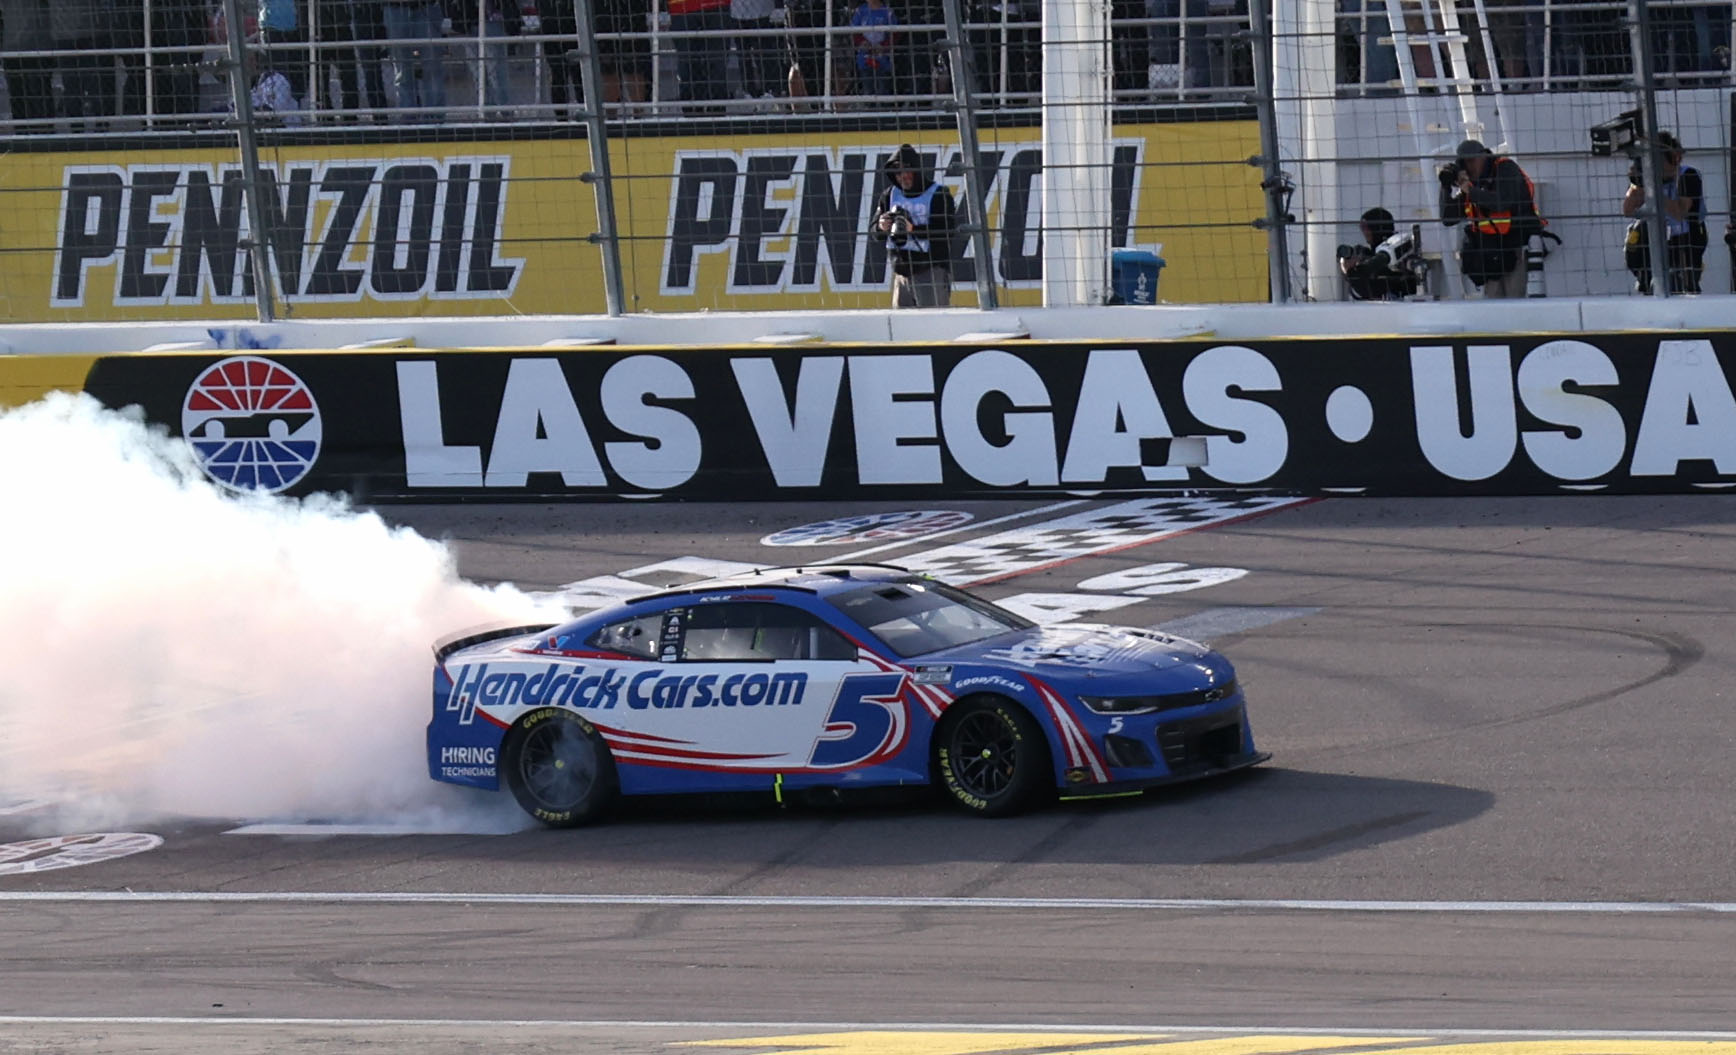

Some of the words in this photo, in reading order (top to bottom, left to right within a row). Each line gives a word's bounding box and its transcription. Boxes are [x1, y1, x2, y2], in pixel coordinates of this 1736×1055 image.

[50, 155, 526, 307] PENNZOIL
[396, 355, 702, 489] LAS
[730, 345, 1289, 488] VEGAS
[1409, 339, 1736, 481] USA
[446, 663, 808, 725] HendrickCars.com
[955, 675, 1025, 692] GOODYEAR
[805, 671, 910, 769] 5
[1108, 716, 1124, 734] 5
[441, 746, 496, 765] HIRING
[441, 766, 496, 777] TECHNICIANS
